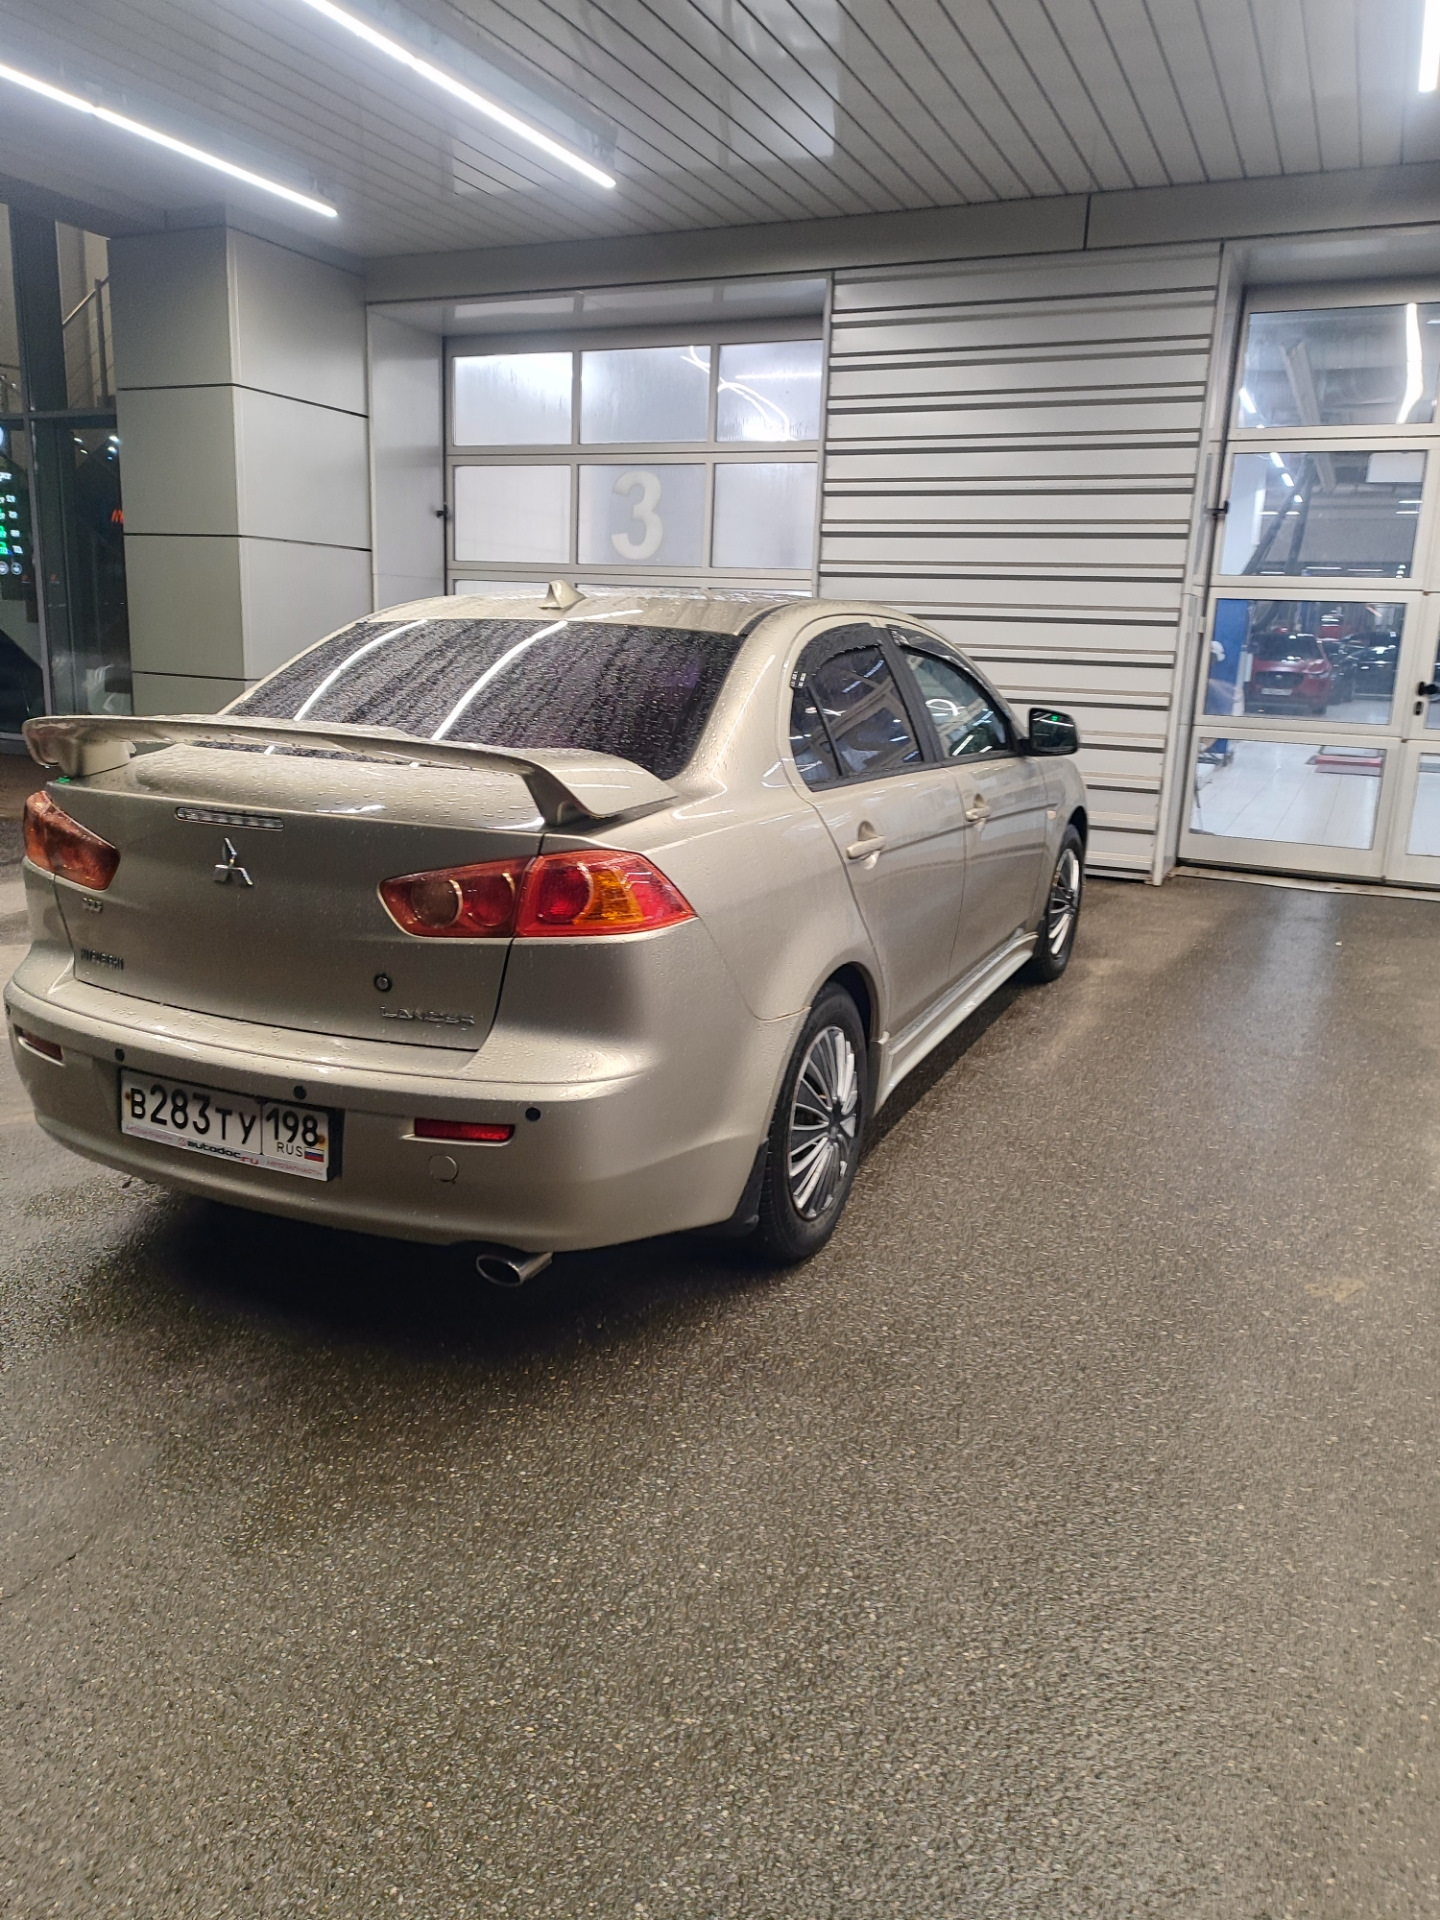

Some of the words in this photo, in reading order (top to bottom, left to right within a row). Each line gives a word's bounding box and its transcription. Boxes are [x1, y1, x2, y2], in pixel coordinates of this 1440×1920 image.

[611, 470, 664, 561] 3
[130, 1084, 256, 1145] В283ТУ
[265, 1108, 318, 1147] 198
[276, 1141, 303, 1158] RUS
